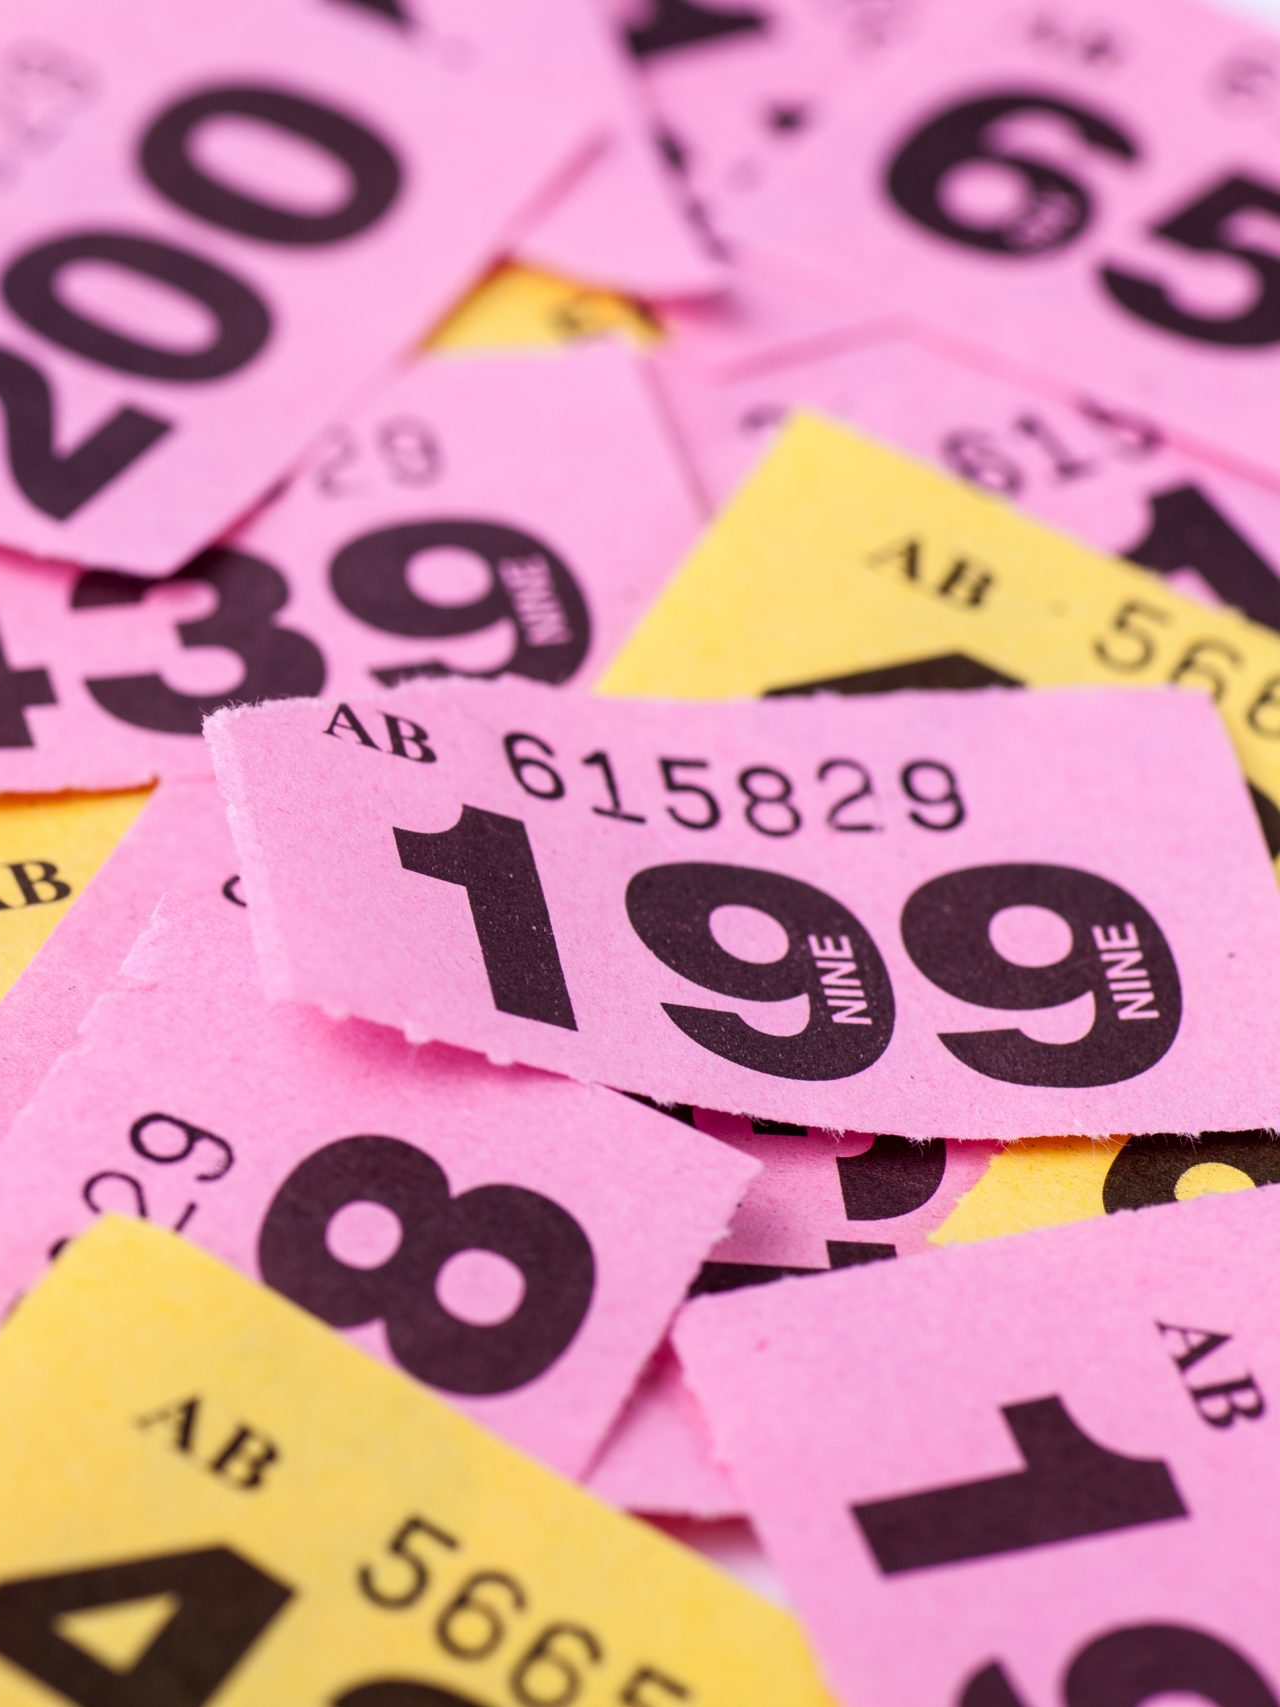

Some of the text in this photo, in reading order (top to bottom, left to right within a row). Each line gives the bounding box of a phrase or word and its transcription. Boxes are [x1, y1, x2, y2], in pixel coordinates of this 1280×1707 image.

[499, 553, 573, 648] NINE
[867, 533, 999, 610] AB
[324, 703, 439, 765] AB
[505, 731, 967, 838] 615829
[392, 803, 1183, 1090] 199
[808, 932, 873, 1026] NINE
[1092, 921, 1160, 1021] NINE
[257, 1134, 597, 1397] 8
[1153, 1320, 1269, 1431] AB
[137, 1393, 283, 1494] AB
